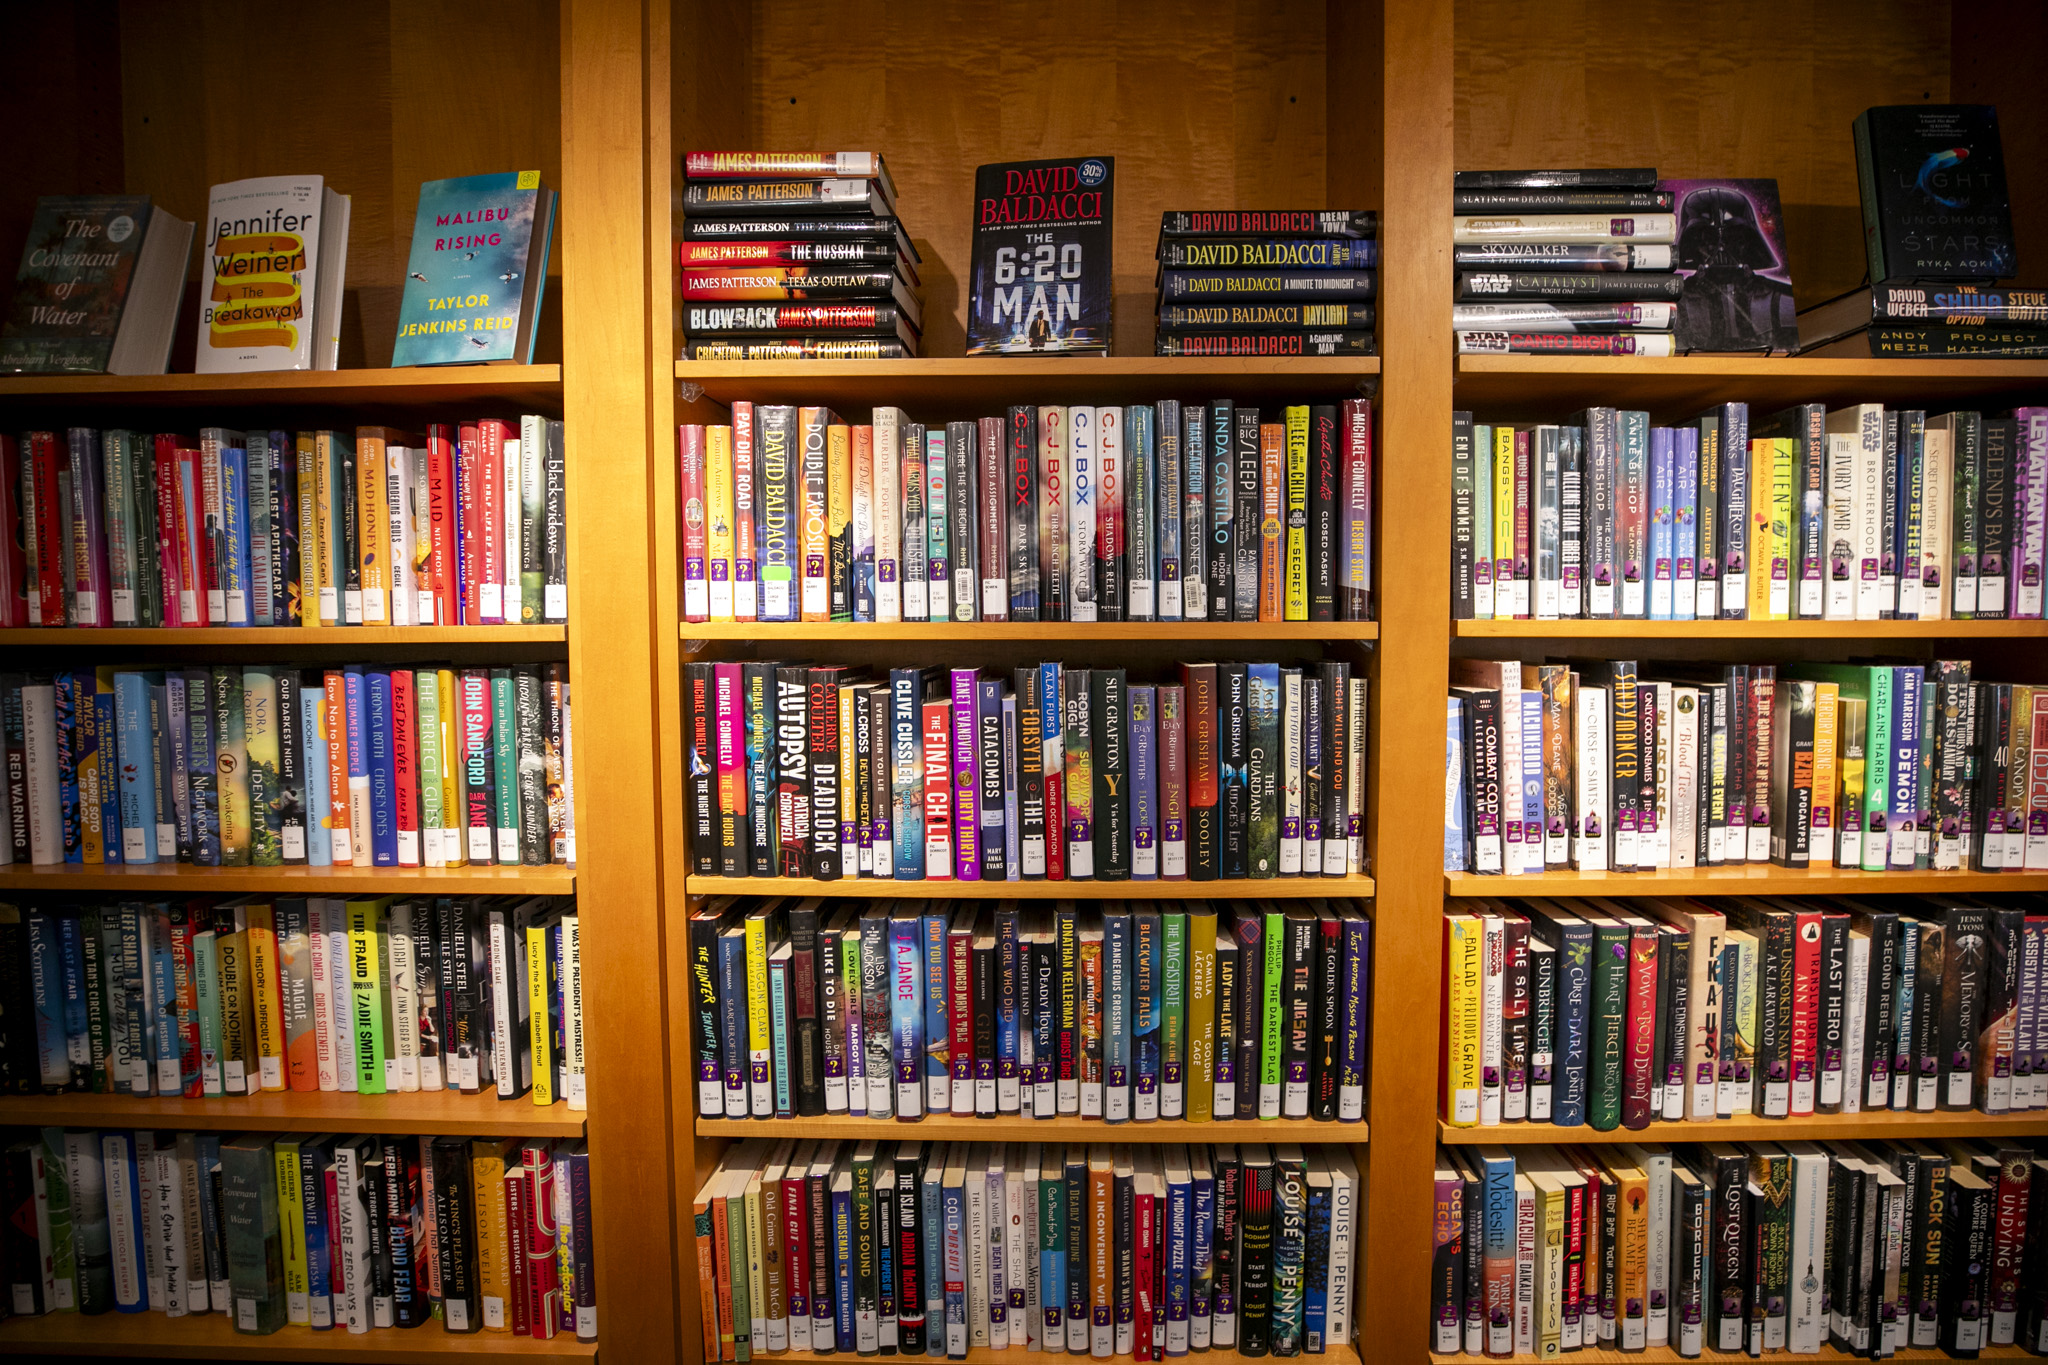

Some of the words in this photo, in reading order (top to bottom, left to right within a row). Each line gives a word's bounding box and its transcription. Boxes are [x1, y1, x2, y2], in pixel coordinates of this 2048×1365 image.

[1005, 167, 1079, 196] DAVID
[980, 192, 1103, 225] BALDACCI
[1462, 195, 1506, 203] SLAYING
[64, 219, 101, 238] The
[208, 208, 312, 247] Jennifer
[437, 208, 509, 226] MALIBU
[1193, 214, 1237, 231] DAVID
[1242, 213, 1314, 231] BALDACCI
[1320, 212, 1349, 222] DREAM
[1323, 222, 1346, 233] TOWN
[435, 233, 501, 251] RISING
[690, 246, 719, 258] JAMES
[721, 246, 768, 258] PATTERSON
[791, 245, 811, 259] THE
[815, 245, 864, 259] RUSSIAN
[1026, 233, 1053, 243] THE
[1481, 245, 1569, 255] SKYWALKER
[29, 249, 120, 266] Covenant
[212, 251, 302, 276] Weiner
[995, 244, 1082, 284] 6:20
[1917, 260, 1952, 268] RYKA
[1960, 260, 1992, 268] AOKI
[55, 276, 81, 300] of
[242, 287, 263, 298] The
[689, 278, 719, 290] JAMES
[721, 277, 776, 288] PATTERSON
[788, 277, 819, 287] TEXAS
[821, 277, 867, 286] OUTLAW
[1888, 289, 1925, 302] DAVID
[30, 306, 87, 325] Water
[205, 304, 302, 323] Breakaway
[428, 294, 489, 311] TAYLOR
[690, 308, 777, 329] BLOWBACK
[993, 284, 1081, 326] MAN
[1187, 307, 1228, 324] DAVID
[1232, 307, 1298, 323] BALDACCI
[1303, 305, 1348, 325] DAYLIGHT
[1887, 303, 1928, 317] WEBER
[400, 319, 467, 337] JENKINS
[474, 317, 512, 330] REID
[1946, 316, 1985, 325] OPTION
[1881, 342, 1929, 351] WEIR
[1951, 333, 2036, 342] PROJECT
[737, 413, 749, 435] PAY
[1015, 413, 1027, 433] C.
[1215, 407, 1228, 456] LINDA
[1352, 413, 1365, 455] MICHAEL
[737, 441, 750, 470] DIRT
[765, 430, 785, 480] DAVID
[1016, 437, 1027, 453] J.
[1456, 436, 1468, 462] END
[548, 459, 564, 497] black
[1016, 458, 1028, 506] BOX
[1352, 460, 1365, 510] CONNELLY
[1457, 467, 1468, 482] OF
[738, 475, 750, 509] ROAD
[1215, 462, 1229, 543] CASTILLO
[1866, 461, 1875, 555] BROTHERHOOD
[548, 500, 561, 554] widows
[766, 484, 786, 566] BALDACCI
[1457, 489, 1469, 542] SUMMER
[523, 518, 533, 569] BLESSINGS
[1018, 524, 1027, 551] DARK
[1352, 520, 1364, 555] DESERT
[1019, 556, 1027, 574] SKY
[1352, 559, 1364, 581] STAR
[955, 676, 970, 705] JANET
[1104, 678, 1116, 702] SUE
[1197, 679, 1208, 714] JOHN
[1903, 673, 1914, 690] KIM
[371, 679, 383, 728] VERONICA
[896, 679, 913, 720] CLIVE
[1875, 675, 1887, 738] CHARLAINE
[778, 682, 806, 780] AUTOPSY
[1901, 693, 1913, 741] HARRISON
[373, 731, 384, 758] ROTH
[957, 710, 973, 763] EVANOVICH
[1105, 705, 1119, 769] GRAFTON
[1198, 720, 1209, 782] GRISHAM
[10, 753, 20, 779] RED
[897, 723, 914, 784] CUSSLER
[983, 716, 1000, 798] CATACOMBS
[1874, 742, 1885, 784] HARRIS
[374, 768, 386, 807] CHOSEN
[1896, 749, 1910, 813] DEMON
[12, 783, 25, 847] WARNING
[780, 792, 793, 843] CORNWELL
[793, 796, 809, 839] PATRICIA
[813, 763, 837, 853] DEADLOCK
[959, 791, 974, 821] DIRTY
[1797, 789, 1807, 848] APOCALYPSE
[376, 810, 387, 836] ONES
[1199, 810, 1210, 868] SOOLEY
[960, 825, 974, 863] THIRTY
[354, 912, 364, 935] THE
[930, 921, 941, 941] NOW
[1002, 921, 1012, 939] THE
[1834, 928, 1842, 945] THE
[355, 940, 366, 977] FRAUD
[930, 945, 941, 963] YOU
[1002, 942, 1012, 964] GIRL
[1061, 918, 1074, 968] JONATHAN
[1515, 935, 1527, 967] THE
[532, 960, 539, 969] by
[931, 966, 941, 983] SEE
[1003, 968, 1012, 992] WHO
[1830, 947, 1841, 991] LAST
[931, 986, 942, 998] US
[1063, 971, 1074, 1028] KELLERMAN
[1514, 976, 1526, 1017] SALT
[1796, 973, 1808, 1003] ANN
[359, 994, 371, 1028] ZADIE
[1004, 997, 1013, 1022] DIED
[1537, 957, 1551, 1054] SUNBRINGER
[1827, 996, 1839, 1041] HERO
[361, 1031, 374, 1070] SMITH
[1193, 1040, 1201, 1066] CAGE
[1512, 1025, 1524, 1063] LINE
[1794, 1011, 1806, 1062] LECKIE
[337, 1154, 351, 1197] RUTH
[899, 1173, 914, 1191] THE
[900, 1194, 915, 1227] ISLAND
[1285, 1171, 1300, 1237] LOUISE
[1928, 1167, 1947, 1223] BLACK
[341, 1201, 352, 1244] WARE
[1519, 1205, 1534, 1252] DRACULA
[1997, 1194, 2015, 1267] UNDYING
[902, 1231, 916, 1267] ADRIAN
[1925, 1230, 1941, 1265] SUN
[903, 1269, 917, 1309] McKINTY
[1282, 1266, 1297, 1326] PENNY
[1519, 1264, 1532, 1302] DAIKAIJU
